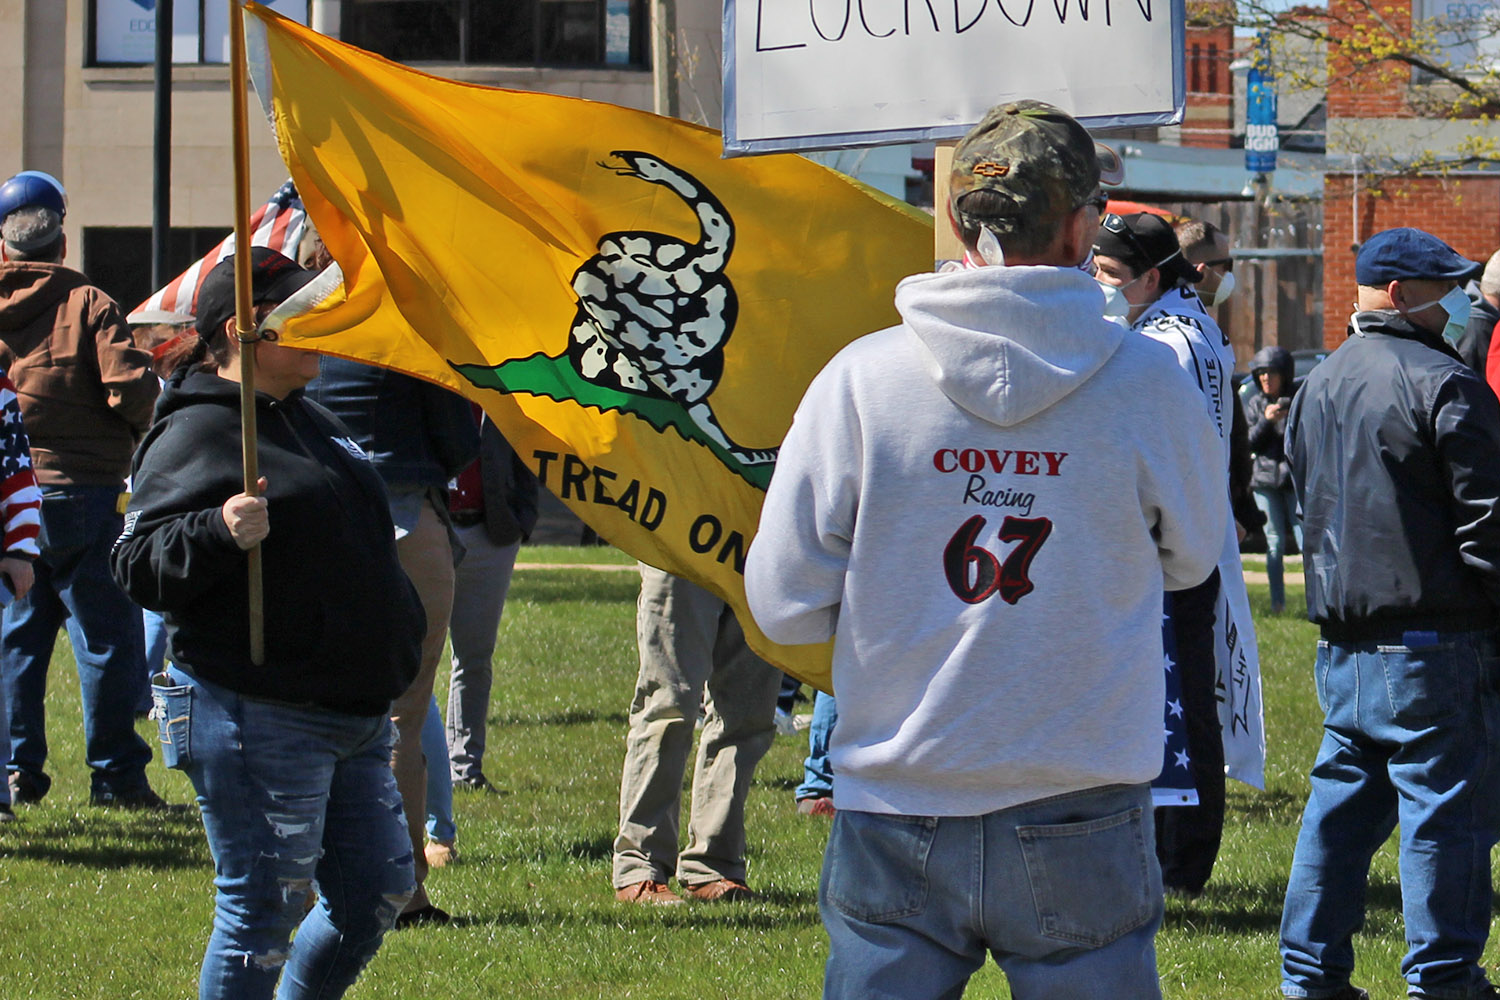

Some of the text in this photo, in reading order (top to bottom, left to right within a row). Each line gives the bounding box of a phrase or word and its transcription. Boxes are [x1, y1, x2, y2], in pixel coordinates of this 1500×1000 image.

[1246, 124, 1277, 138] BUD
[1205, 358, 1223, 438] MINUTE
[533, 450, 667, 532] TREAD
[933, 448, 1069, 476] COVEY
[963, 474, 1036, 517] Racing
[943, 514, 1053, 606] 67
